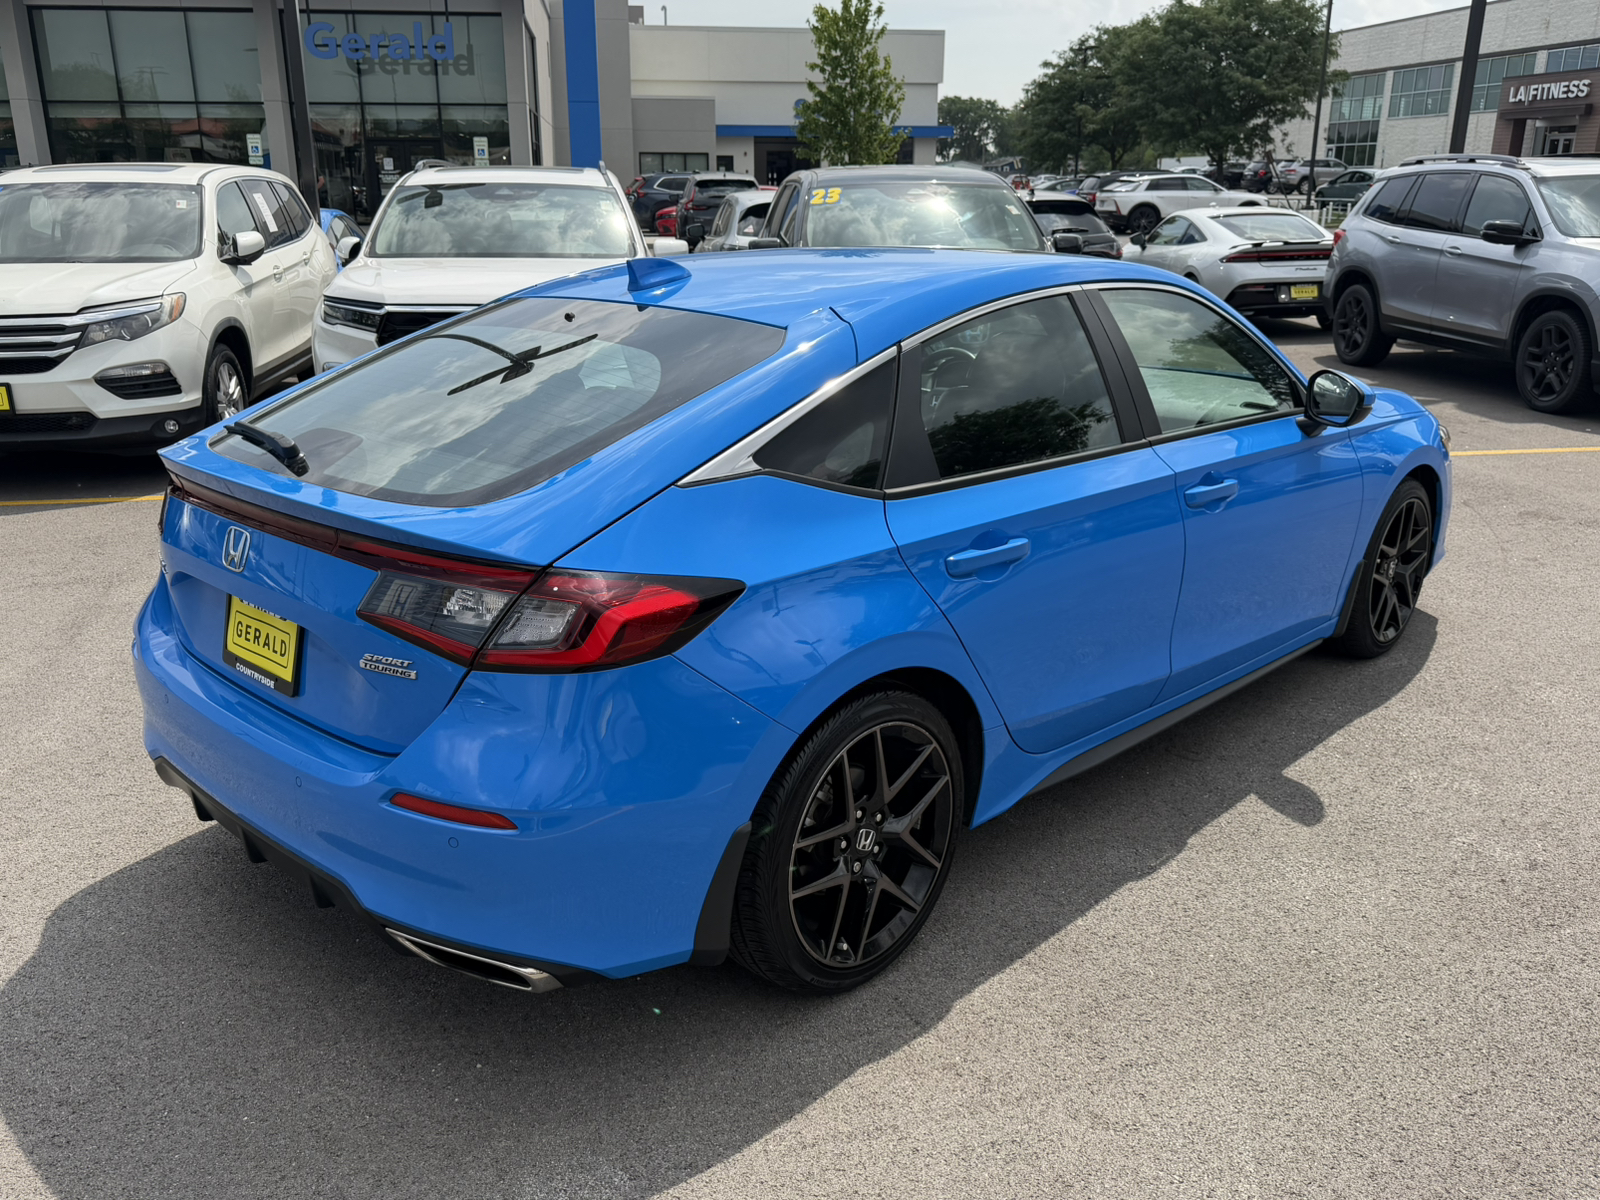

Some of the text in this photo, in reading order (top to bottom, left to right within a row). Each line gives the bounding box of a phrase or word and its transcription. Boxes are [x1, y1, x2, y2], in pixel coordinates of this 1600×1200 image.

[304, 21, 455, 61] Gerald
[810, 187, 842, 205] 23
[236, 620, 287, 658] GERALD
[361, 661, 412, 678] TOURING
[362, 653, 414, 667] SPORT
[235, 662, 275, 690] COUNTRYSIDE
